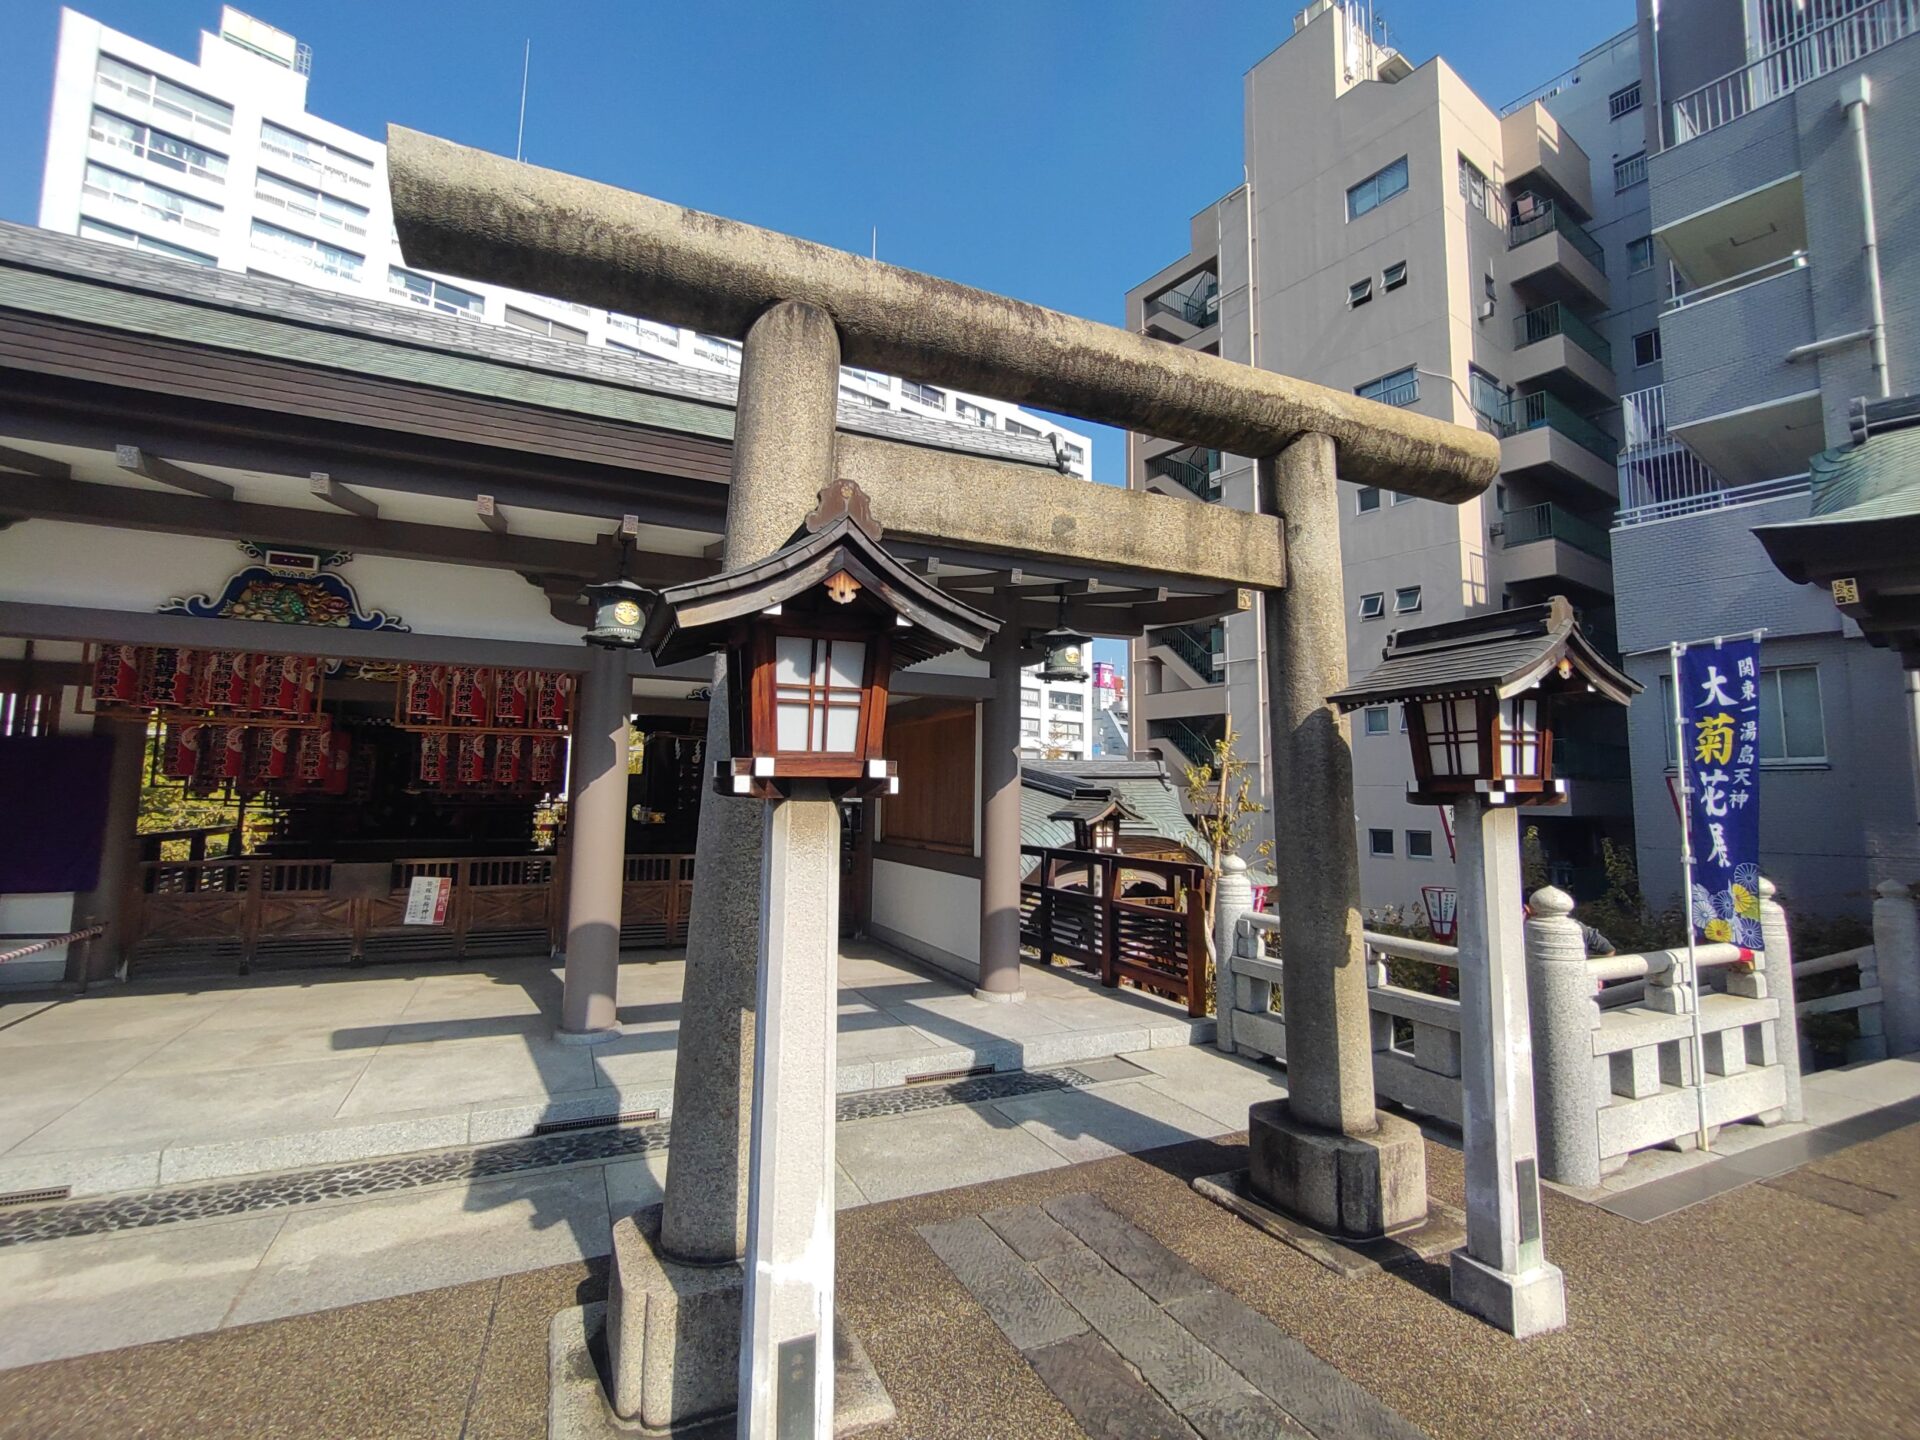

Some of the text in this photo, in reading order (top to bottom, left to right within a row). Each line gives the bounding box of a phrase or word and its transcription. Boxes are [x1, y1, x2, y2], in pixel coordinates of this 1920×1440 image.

[1695, 666, 1739, 868] 大菊花展
[1728, 658, 1757, 810] 関東一湯島天神
